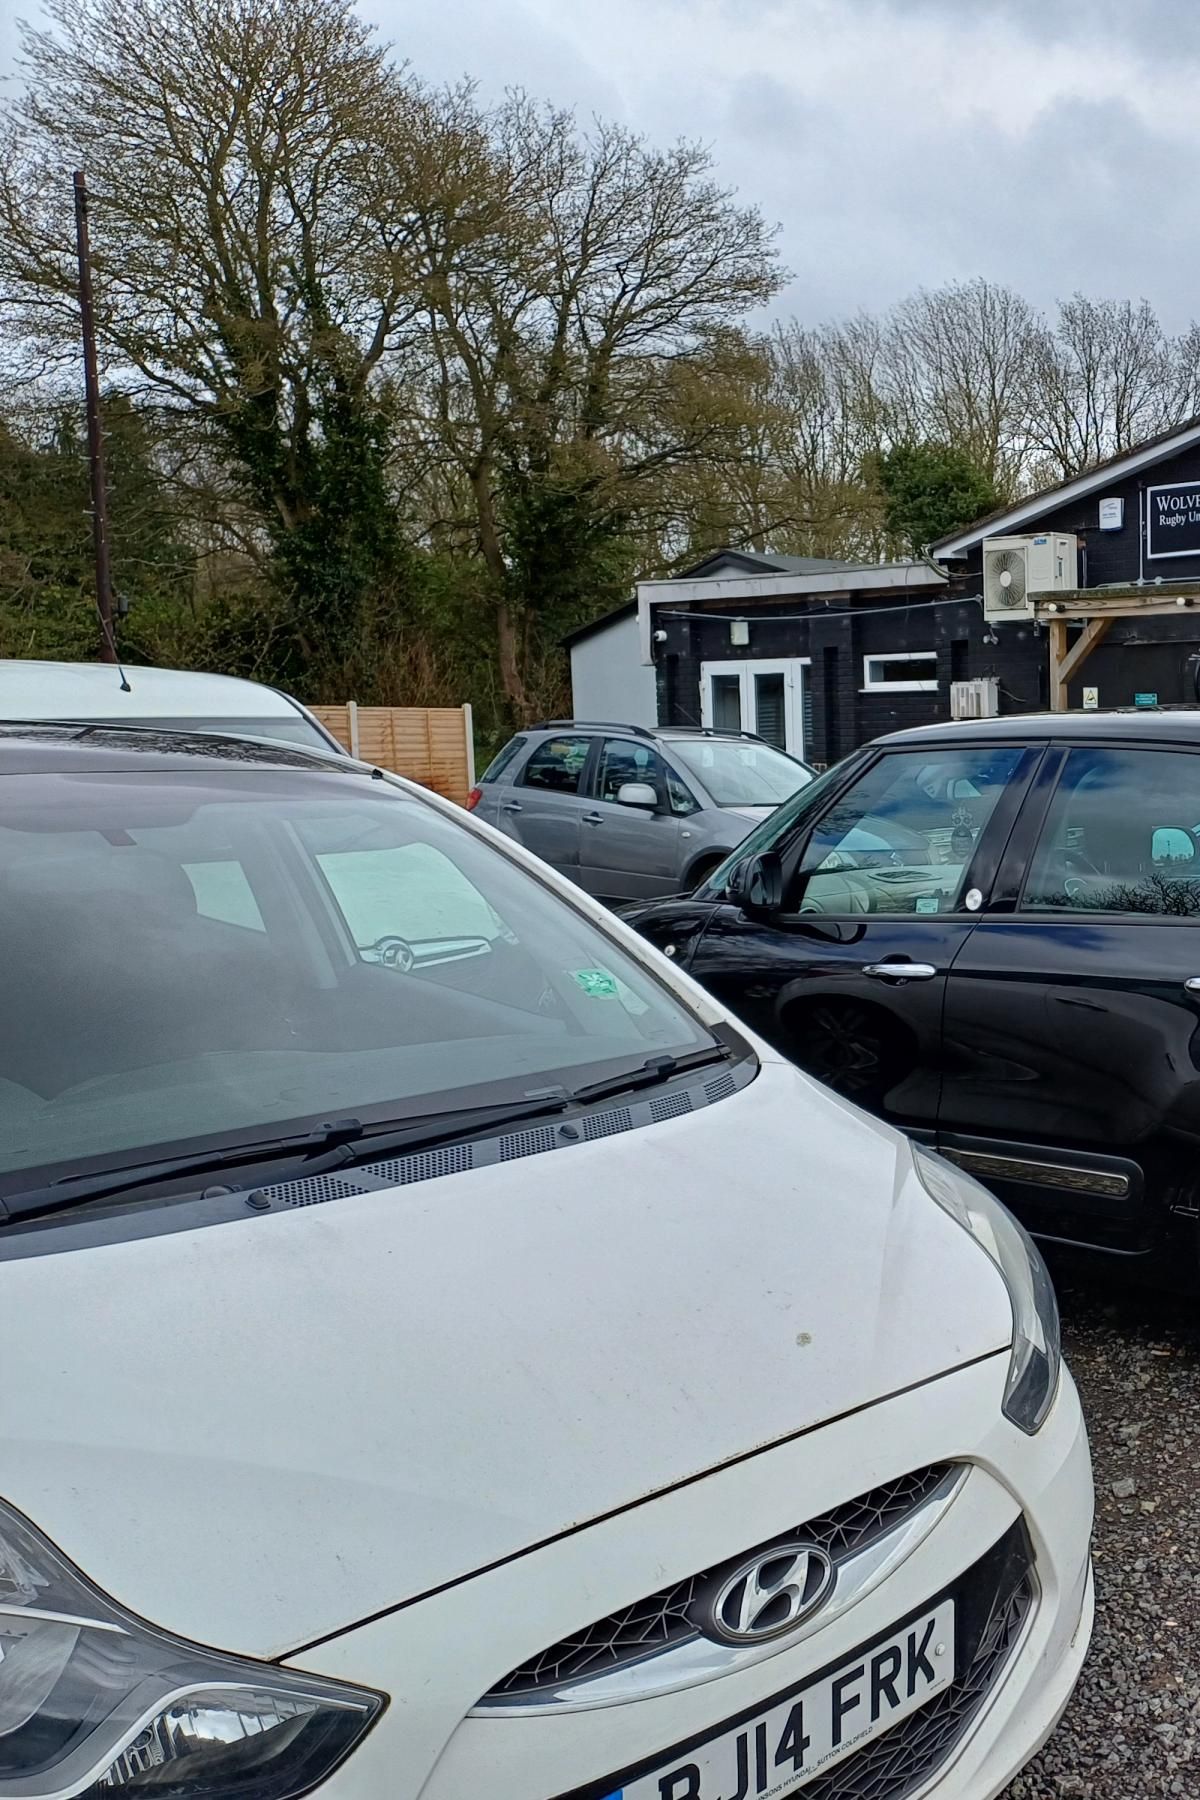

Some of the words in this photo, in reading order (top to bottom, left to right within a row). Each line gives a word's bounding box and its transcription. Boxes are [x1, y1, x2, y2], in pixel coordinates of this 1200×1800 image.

[1159, 513, 1186, 527] Rugby
[832, 1617, 936, 1748] FRK
[817, 1748, 840, 1767] SUTTON
[841, 1726, 873, 1751] COLDFIELD
